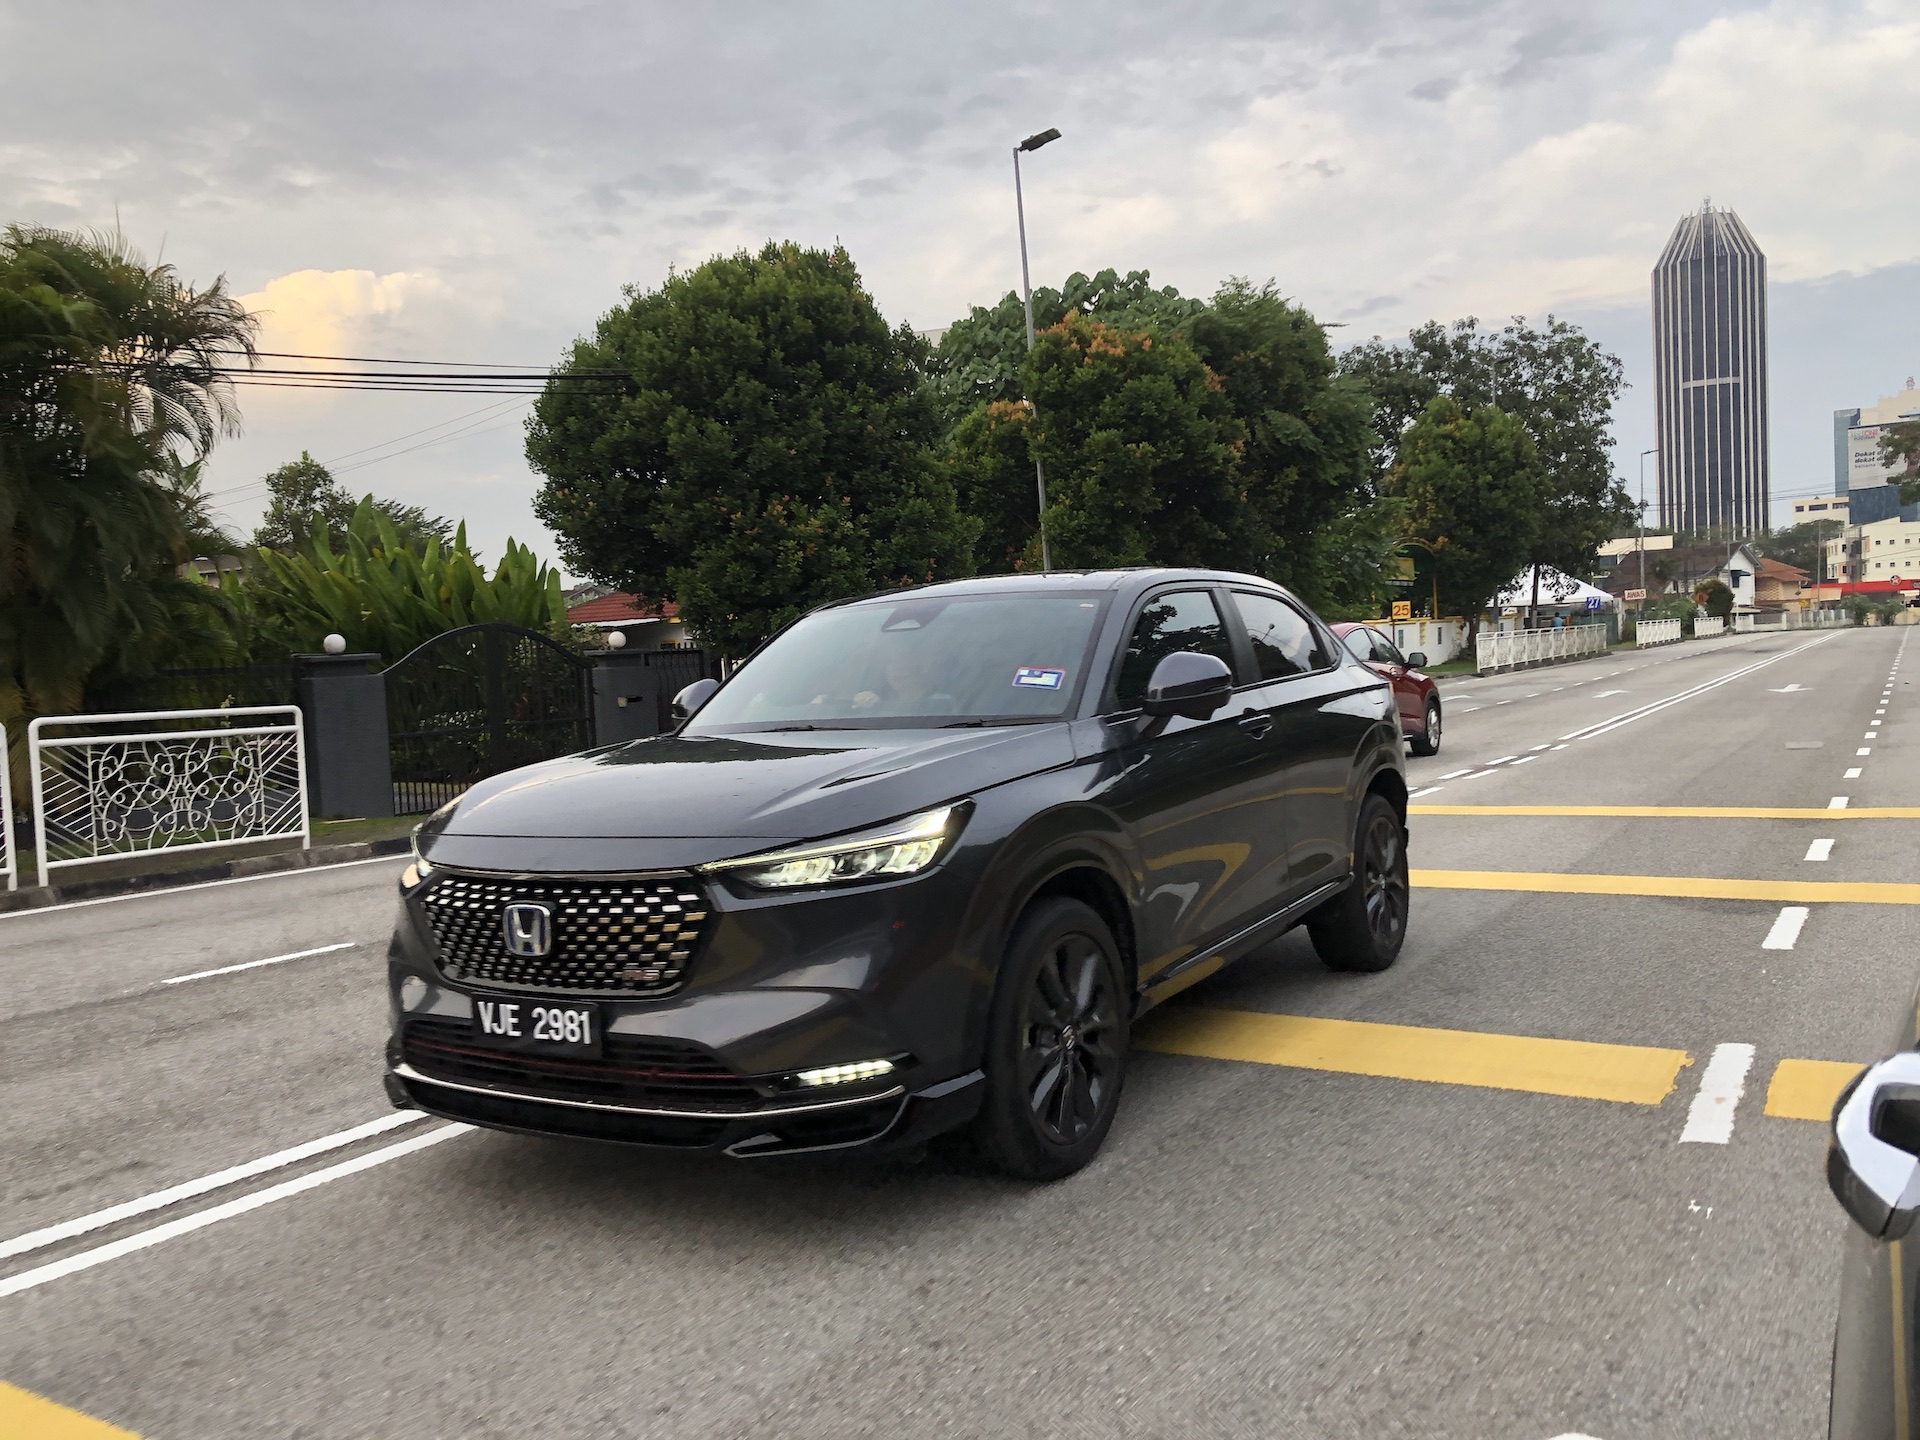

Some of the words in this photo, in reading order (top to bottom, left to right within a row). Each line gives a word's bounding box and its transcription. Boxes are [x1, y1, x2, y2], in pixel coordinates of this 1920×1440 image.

[1627, 590, 1645, 598] AWAS
[1588, 597, 1600, 609] 27
[1393, 604, 1410, 617] 25
[477, 1001, 522, 1037] VJE
[531, 1007, 592, 1045] 2981
